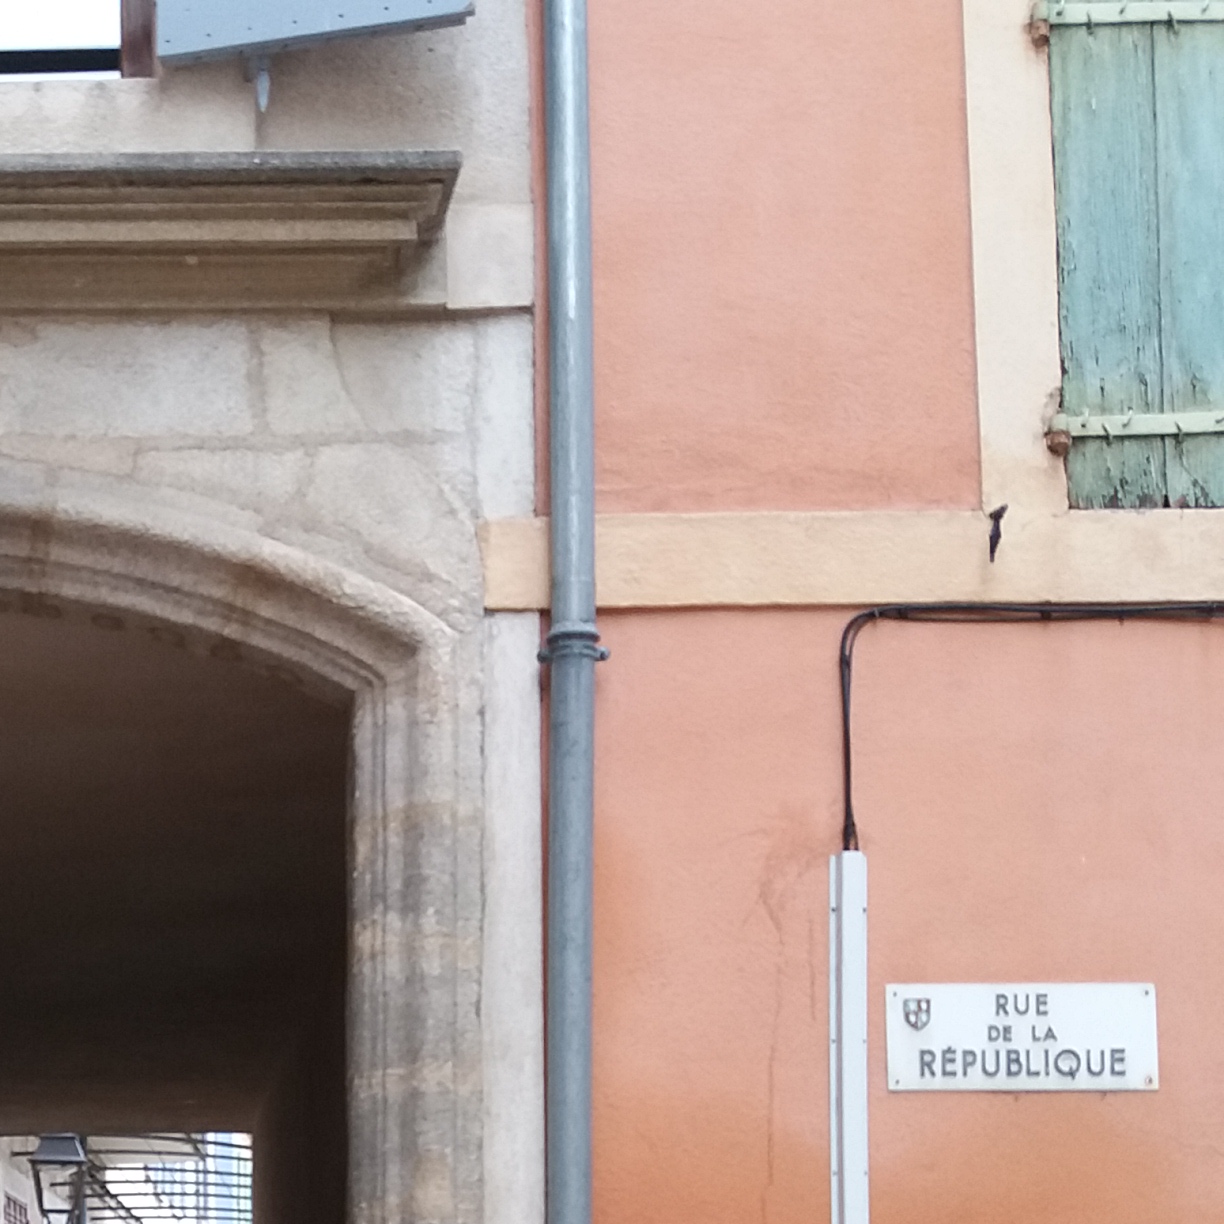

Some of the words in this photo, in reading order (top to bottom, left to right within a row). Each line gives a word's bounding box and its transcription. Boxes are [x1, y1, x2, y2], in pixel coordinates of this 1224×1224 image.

[995, 994, 1048, 1016] RUE
[987, 1025, 1013, 1042] DE
[1031, 1025, 1057, 1042] LA
[919, 1046, 1127, 1080] RÉPUBLIQUE
